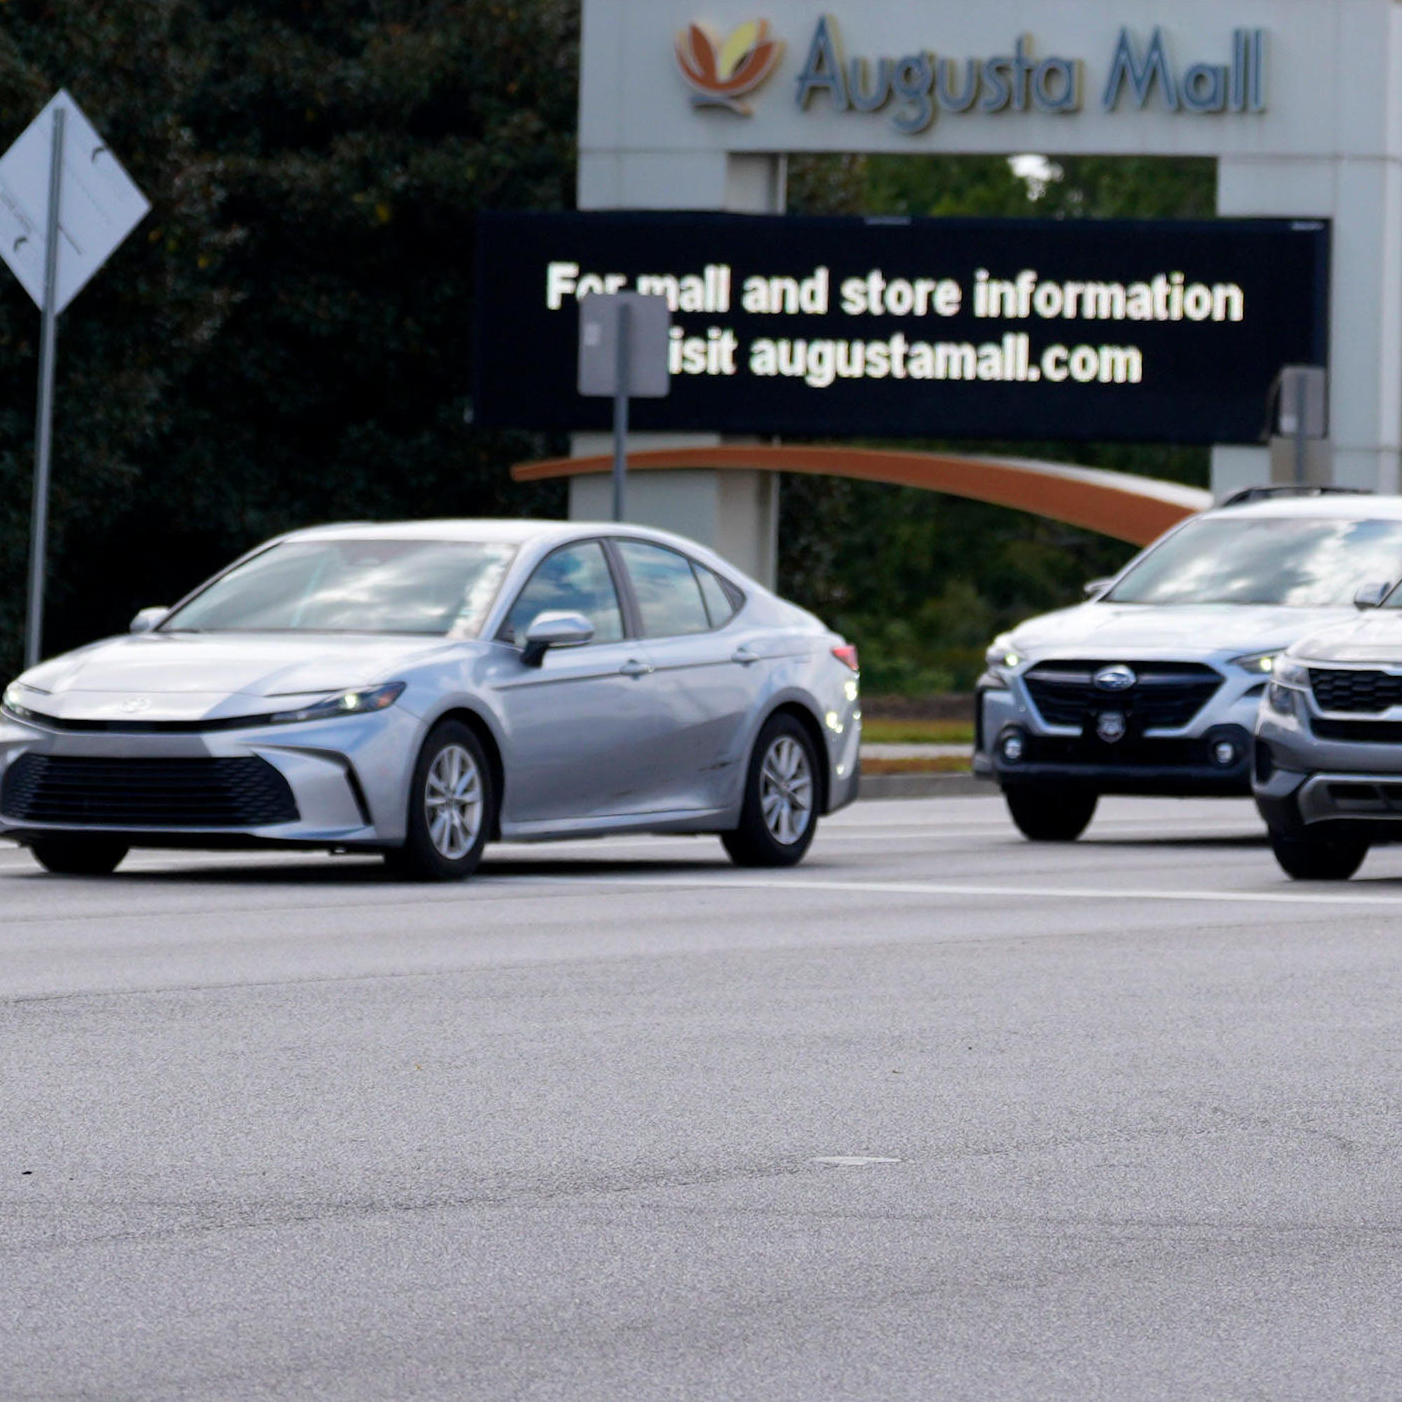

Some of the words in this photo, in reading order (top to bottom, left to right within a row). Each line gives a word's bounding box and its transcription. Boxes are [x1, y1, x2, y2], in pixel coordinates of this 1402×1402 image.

[796, 13, 1082, 135] Augusta
[1102, 25, 1268, 114] Mall
[741, 265, 830, 315] and
[840, 268, 962, 316] store
[972, 267, 1245, 322] information
[667, 325, 739, 376] isit
[749, 330, 1144, 388] augustamall.com
